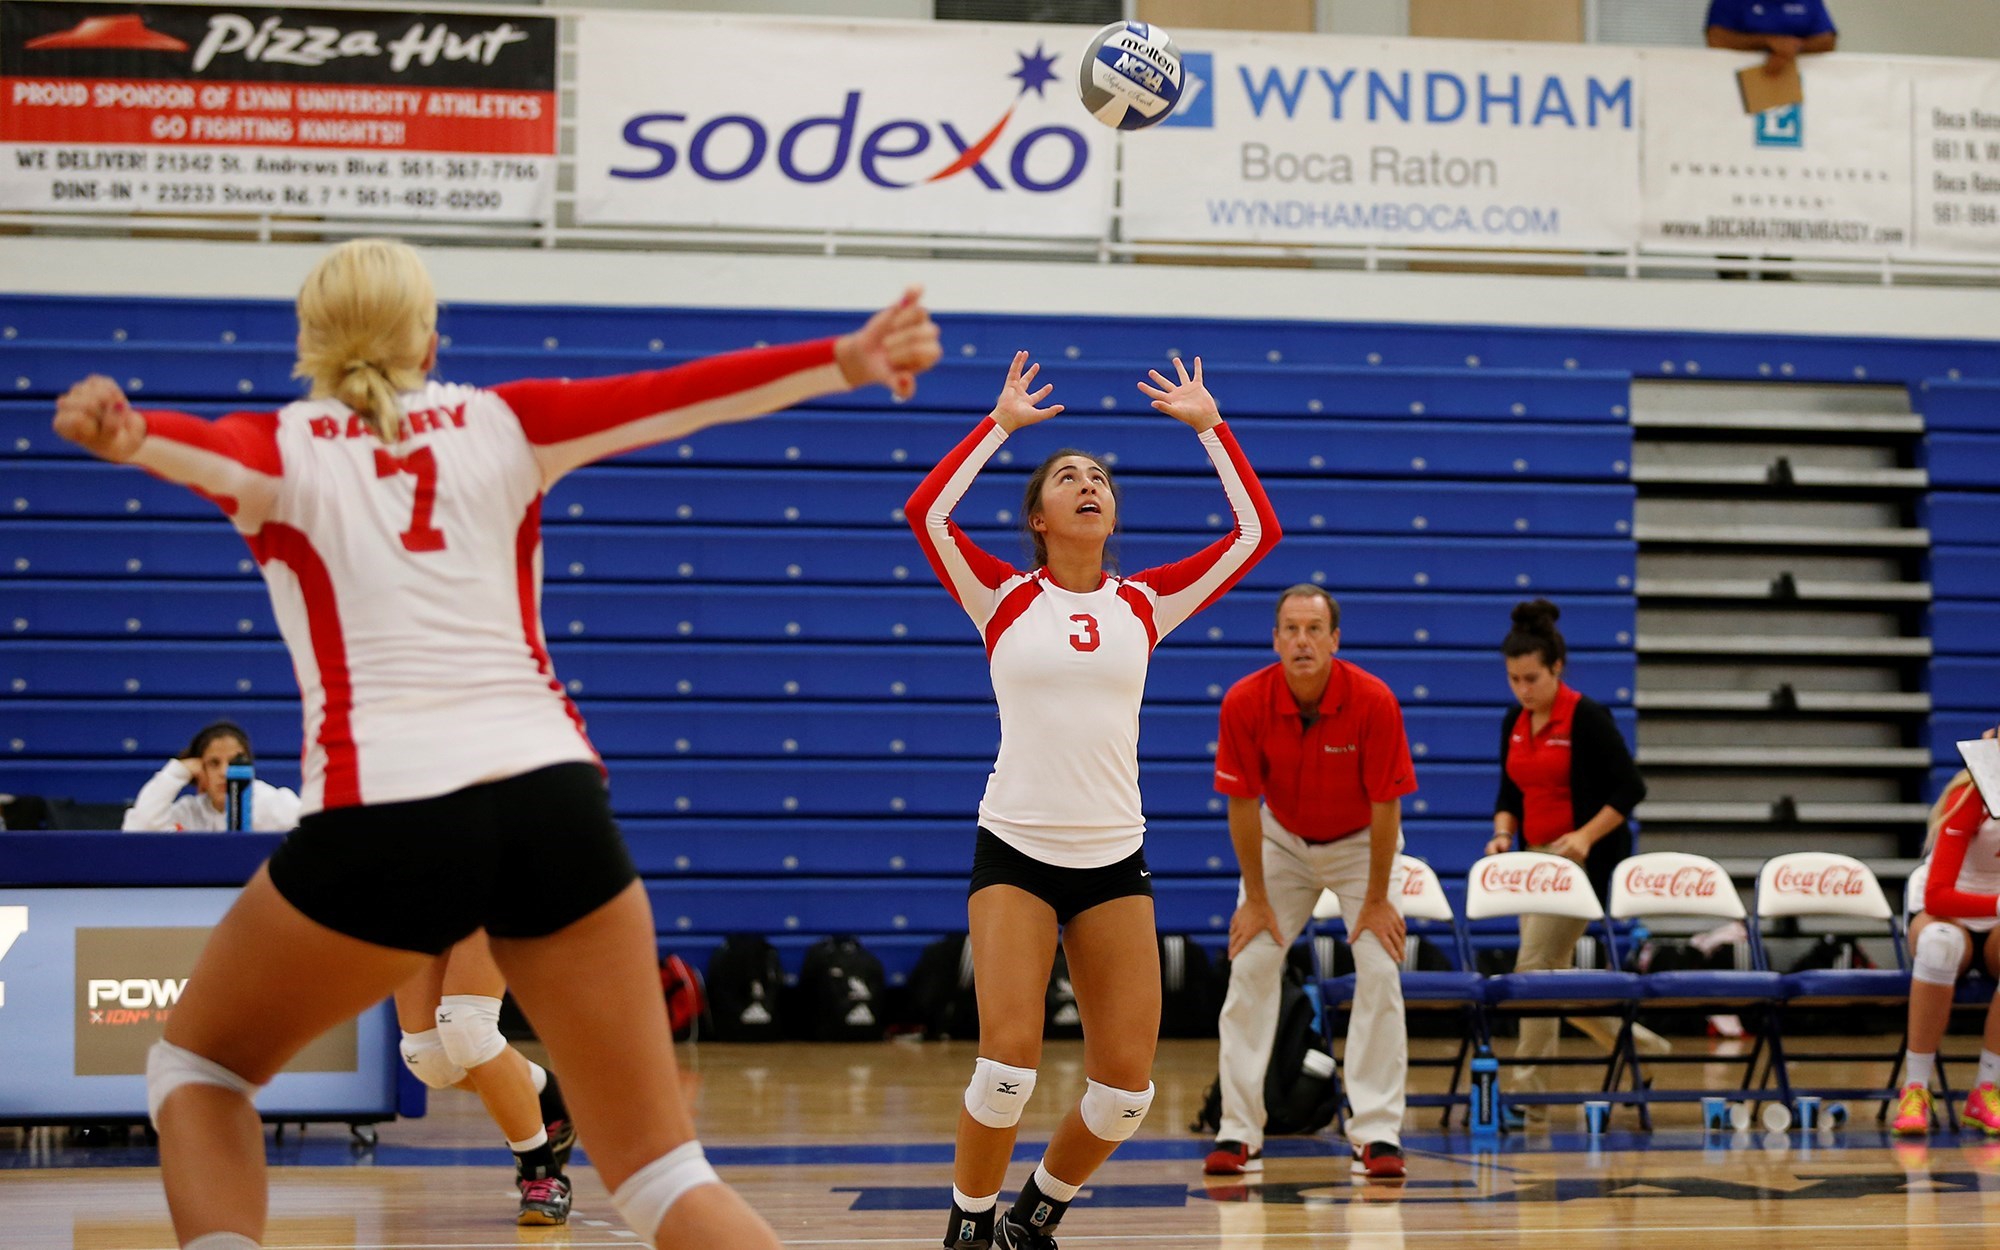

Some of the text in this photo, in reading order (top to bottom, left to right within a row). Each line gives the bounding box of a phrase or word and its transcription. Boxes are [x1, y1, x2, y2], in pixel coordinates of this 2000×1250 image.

[192, 13, 529, 72] Pizza Hut
[1121, 38, 1175, 76] molten
[1113, 52, 1164, 95] NCAA
[13, 81, 543, 120] PROUD SPONSOR OF LYNN UNIVERSITY ATHLETICS
[1237, 64, 1634, 130] WYNDHAM
[151, 114, 188, 140] GO
[190, 116, 295, 142] FIGHTING
[608, 90, 1090, 193] sodexo
[16, 149, 48, 170] WE
[57, 150, 148, 171] DELIVER!
[254, 156, 339, 178] Andrews
[1240, 142, 1499, 188] Boca Raton
[53, 180, 132, 200] DINE-IN
[223, 184, 276, 204] State
[1207, 199, 1559, 235] WYNDHAMBOCA.COM
[373, 445, 448, 553] 7
[1069, 613, 1101, 653] 3
